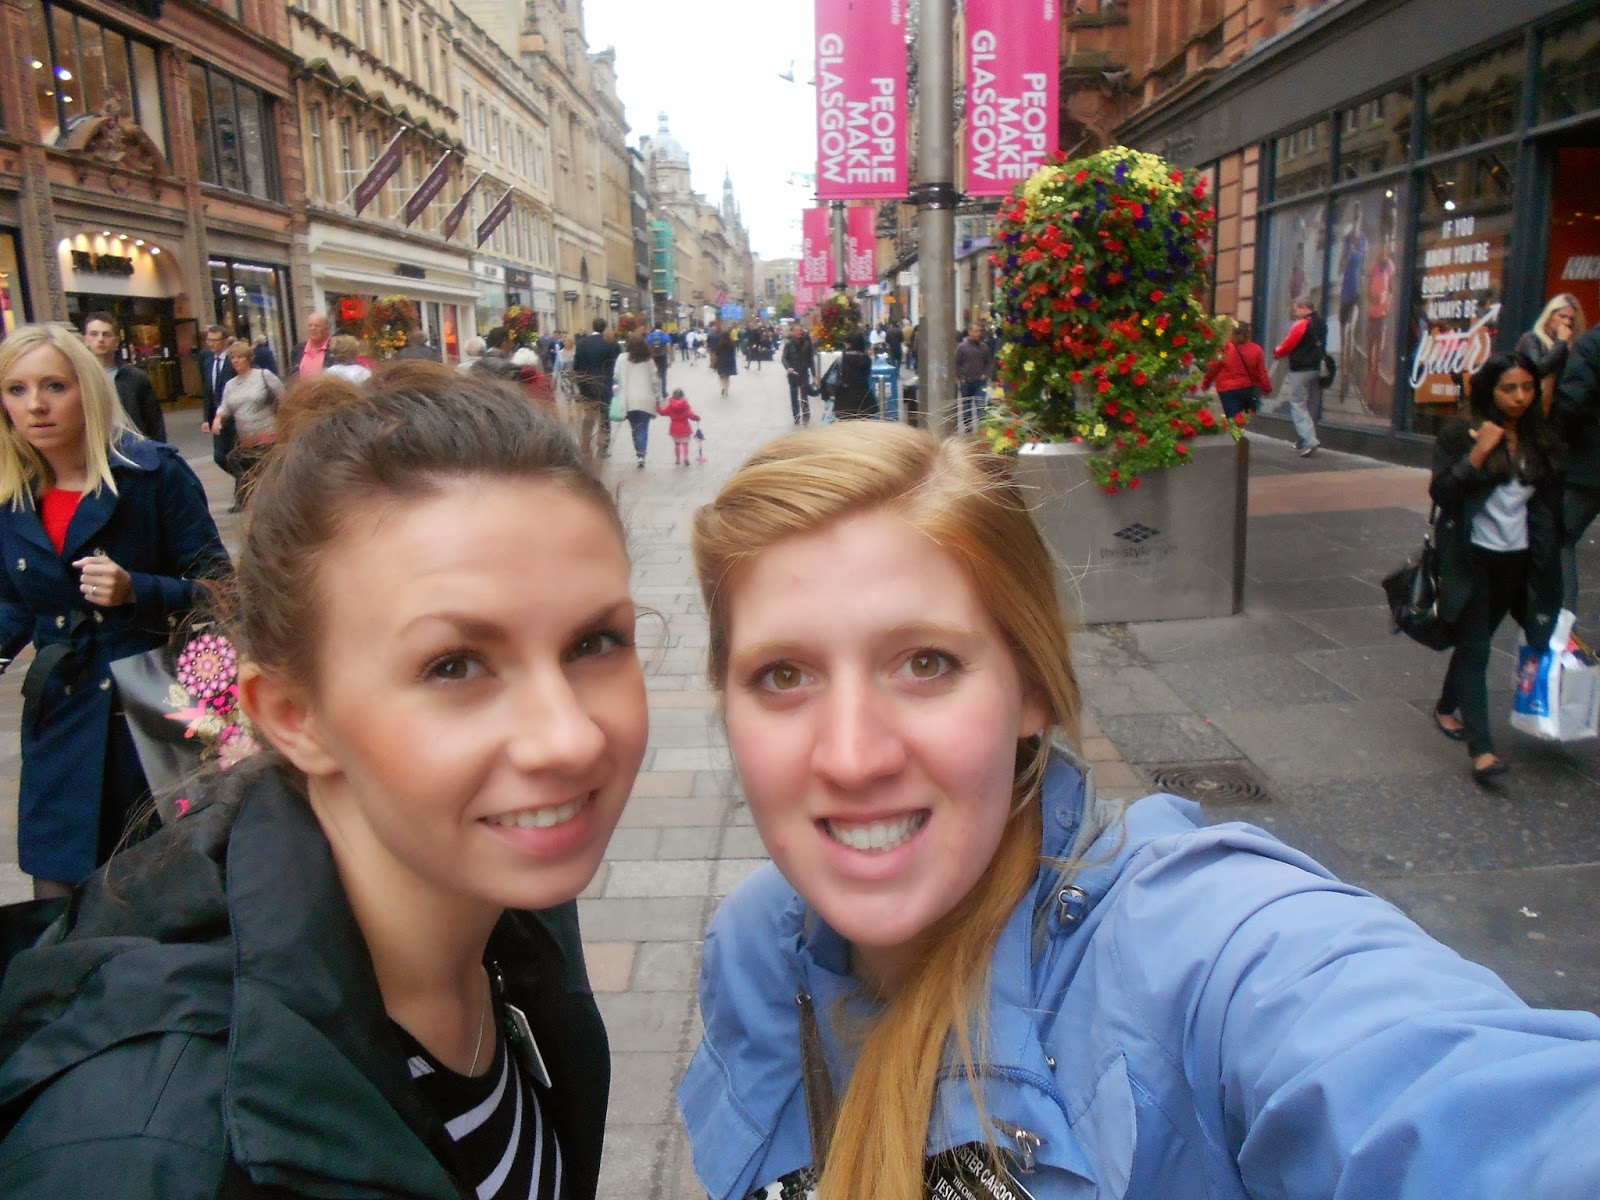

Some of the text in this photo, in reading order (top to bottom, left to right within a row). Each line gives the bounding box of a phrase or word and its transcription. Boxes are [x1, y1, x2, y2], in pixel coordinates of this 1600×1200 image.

[819, 32, 845, 183] GLASGOW
[846, 101, 870, 183] MAKE
[871, 77, 896, 183] PEOPLE
[971, 29, 997, 180] GLASGOW
[998, 97, 1021, 180] MAKE
[1022, 72, 1047, 179] PEOPLE
